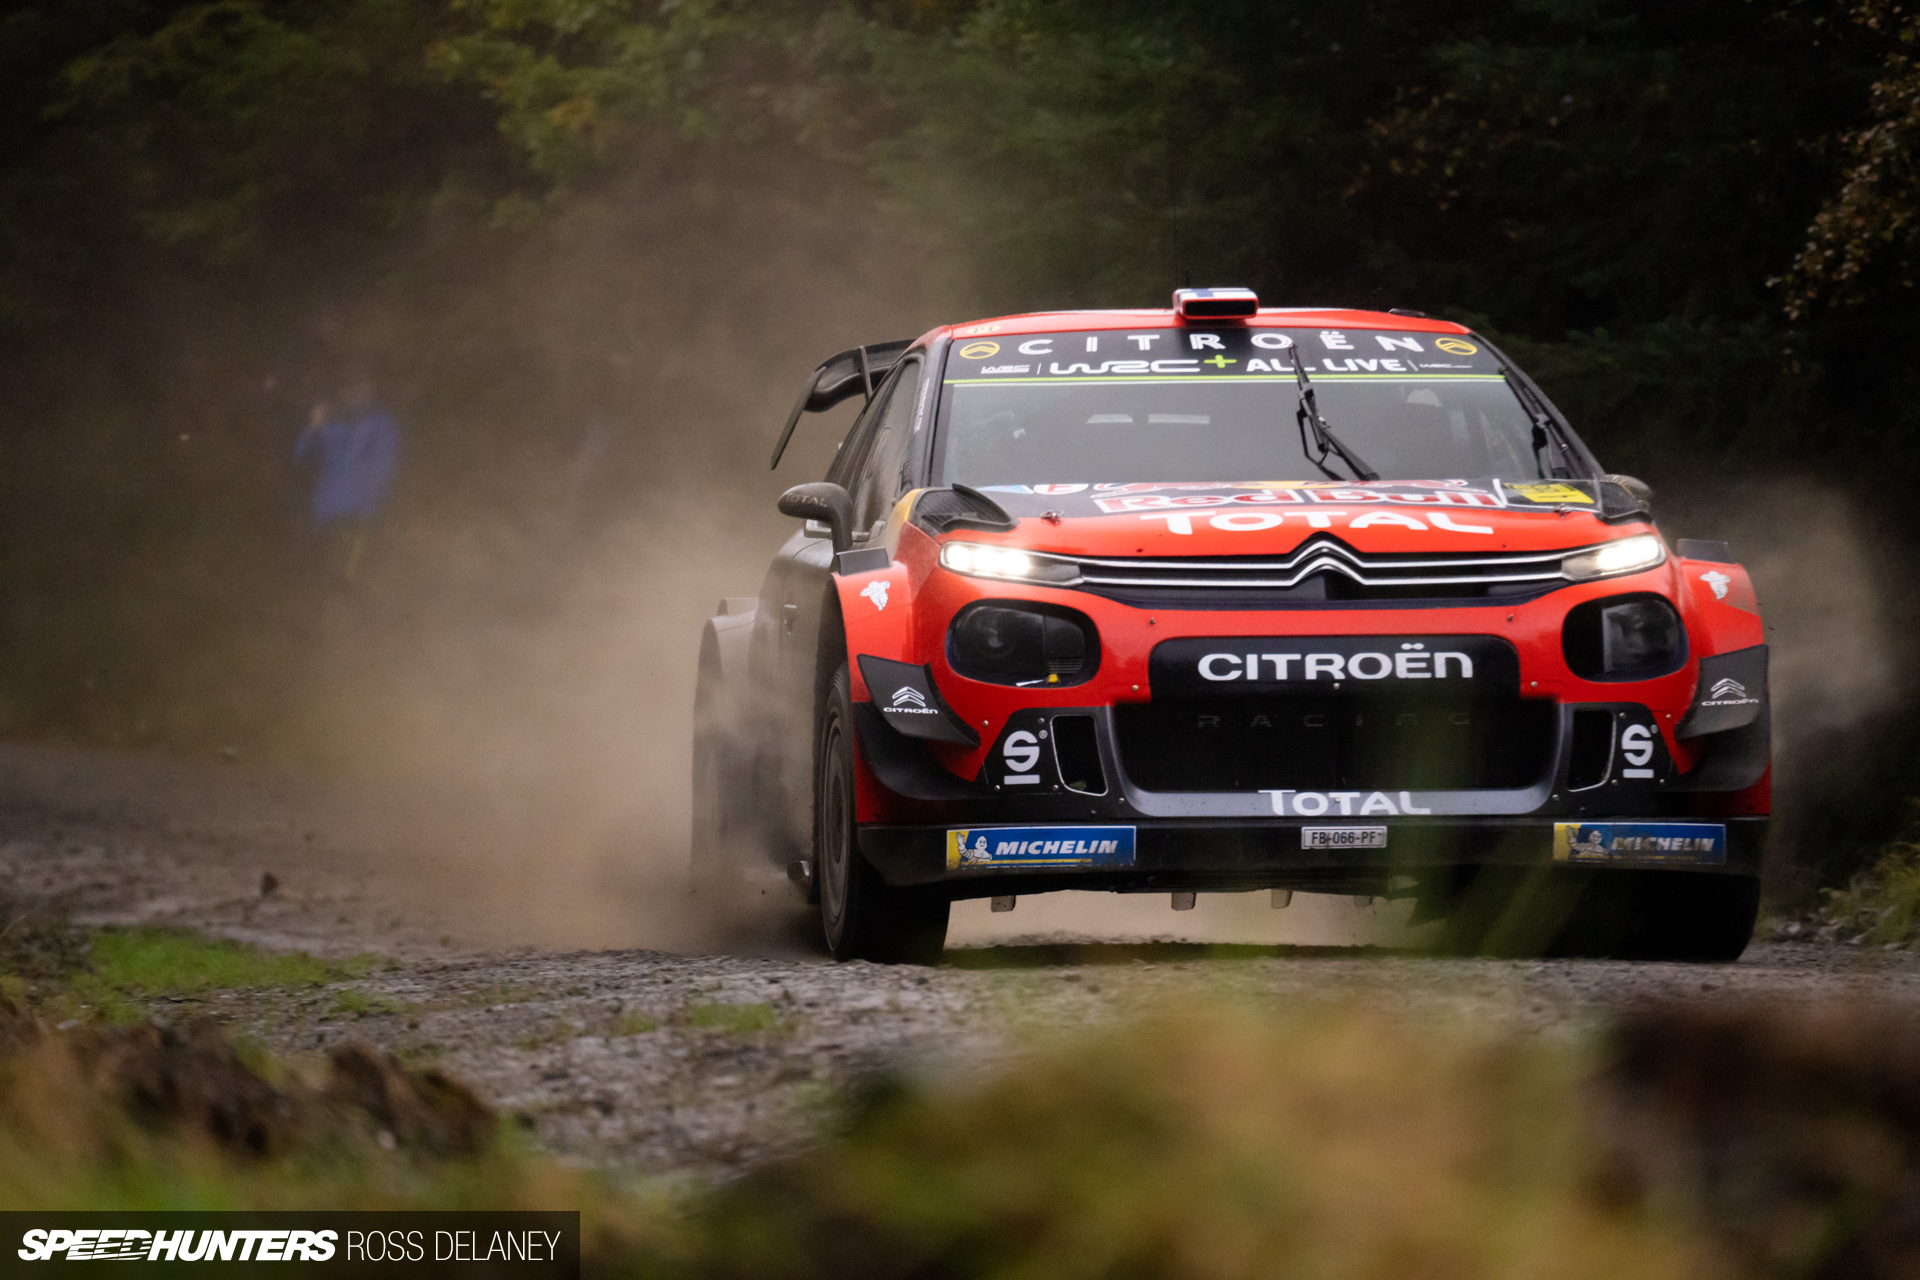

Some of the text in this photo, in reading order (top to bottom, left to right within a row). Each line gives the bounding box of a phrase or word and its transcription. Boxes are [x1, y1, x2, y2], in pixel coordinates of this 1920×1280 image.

[1018, 331, 1425, 355] CITROËN
[1322, 358, 1407, 372] LIVE
[1140, 511, 1494, 535] TOTAL
[1198, 643, 1473, 681] CITROËN
[1258, 789, 1431, 816] TOTAL
[995, 840, 1118, 855] MICHELIN
[1611, 837, 1715, 851] MICHELIN
